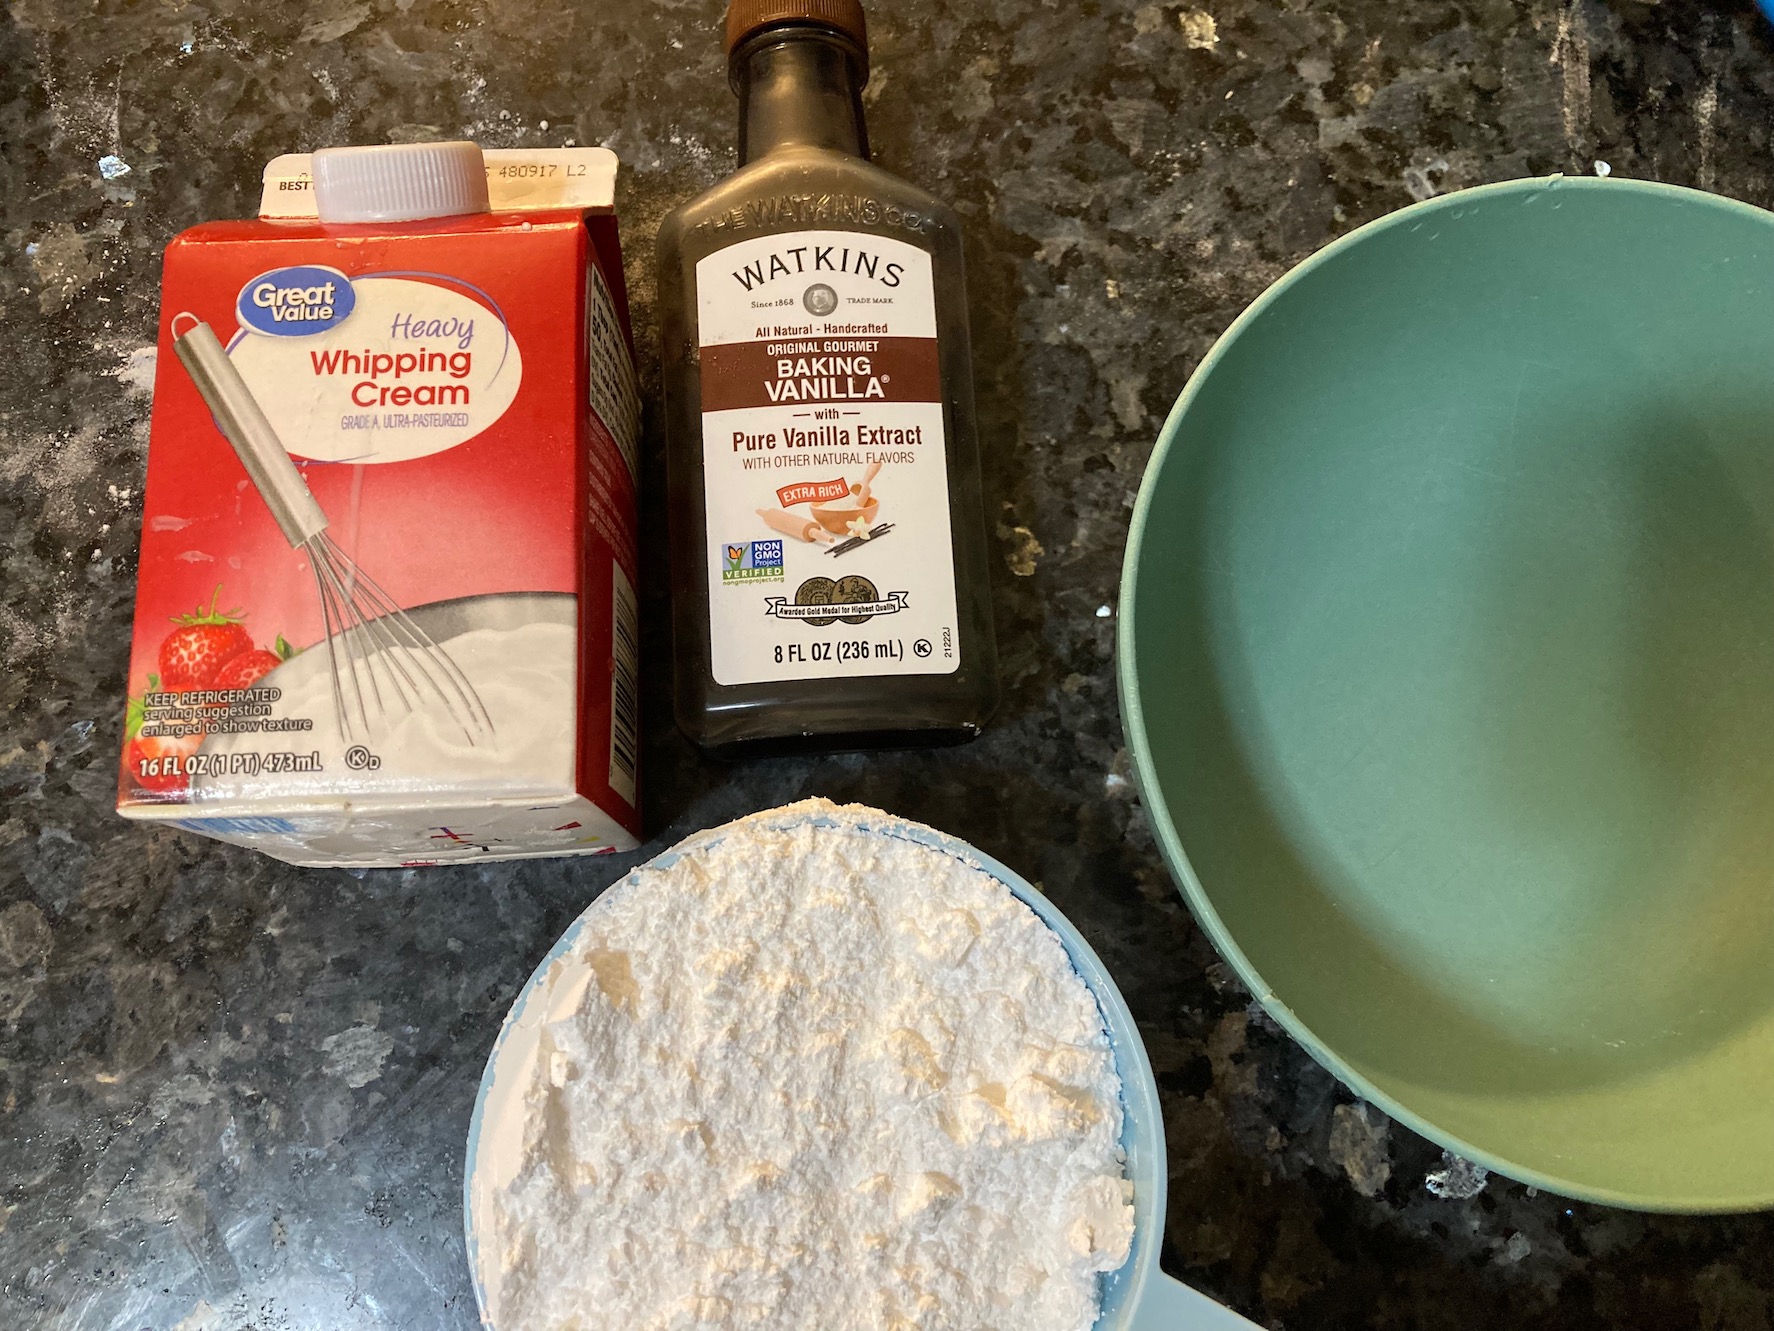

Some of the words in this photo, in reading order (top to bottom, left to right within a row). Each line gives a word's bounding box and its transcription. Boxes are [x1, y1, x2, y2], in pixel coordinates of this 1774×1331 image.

[499, 165, 557, 178] 480917
[567, 164, 586, 177] L2
[280, 181, 308, 191] BEST
[747, 193, 882, 228] WATKINS
[732, 246, 905, 292] WATKINS
[253, 281, 336, 308] Great
[751, 300, 773, 309] Since
[774, 298, 794, 307] 1868
[846, 297, 871, 305] TRADE
[271, 303, 334, 322] Value
[391, 312, 474, 349] Heavy
[755, 326, 770, 338] All
[773, 324, 813, 336] Natural
[824, 323, 888, 335] Handcrafted
[767, 341, 821, 356] ORIGINAL
[823, 340, 879, 353] GOURMET
[310, 348, 471, 379] Whipping
[777, 356, 872, 378] BAKING
[351, 381, 470, 407] Cream
[341, 413, 371, 430] GRADE
[383, 412, 469, 429] ULTRA-PASTEURIZED
[814, 408, 839, 420] with
[732, 431, 776, 452] Pure
[783, 426, 850, 448] Vanilla
[857, 425, 922, 446] Extract
[743, 456, 771, 470] WITH
[774, 453, 810, 468] OTHER
[814, 451, 864, 466] NATURAL
[866, 451, 915, 464] FLAVORS
[783, 488, 815, 503] EXTRA
[818, 484, 843, 498] RICH
[754, 542, 781, 551] NON
[755, 550, 781, 559] GMO
[755, 558, 781, 568] Project
[722, 576, 785, 586] nongmoproject.org
[725, 568, 782, 579] VERIFIED
[779, 607, 805, 616] Awarded
[807, 607, 820, 615] Gold
[822, 606, 840, 614] Medal
[842, 605, 850, 614] for
[852, 605, 874, 614] Highest
[875, 603, 896, 612] Quality
[943, 626, 952, 658] 21222J
[774, 645, 783, 663] 8
[788, 644, 806, 662] FL
[811, 642, 832, 661] OZ
[836, 641, 869, 664] (236
[875, 639, 904, 661] mL)
[144, 692, 178, 706] KEEP
[180, 688, 281, 705] REFRIGERATED
[143, 705, 194, 721] serving
[196, 704, 271, 720] suggestion
[141, 722, 201, 738] enlarged
[205, 720, 219, 733] to
[220, 718, 260, 733] show
[262, 717, 312, 732] texture
[139, 757, 159, 777] 16
[162, 756, 181, 776] FL
[185, 755, 208, 774] OZ
[232, 753, 260, 776] PT)
